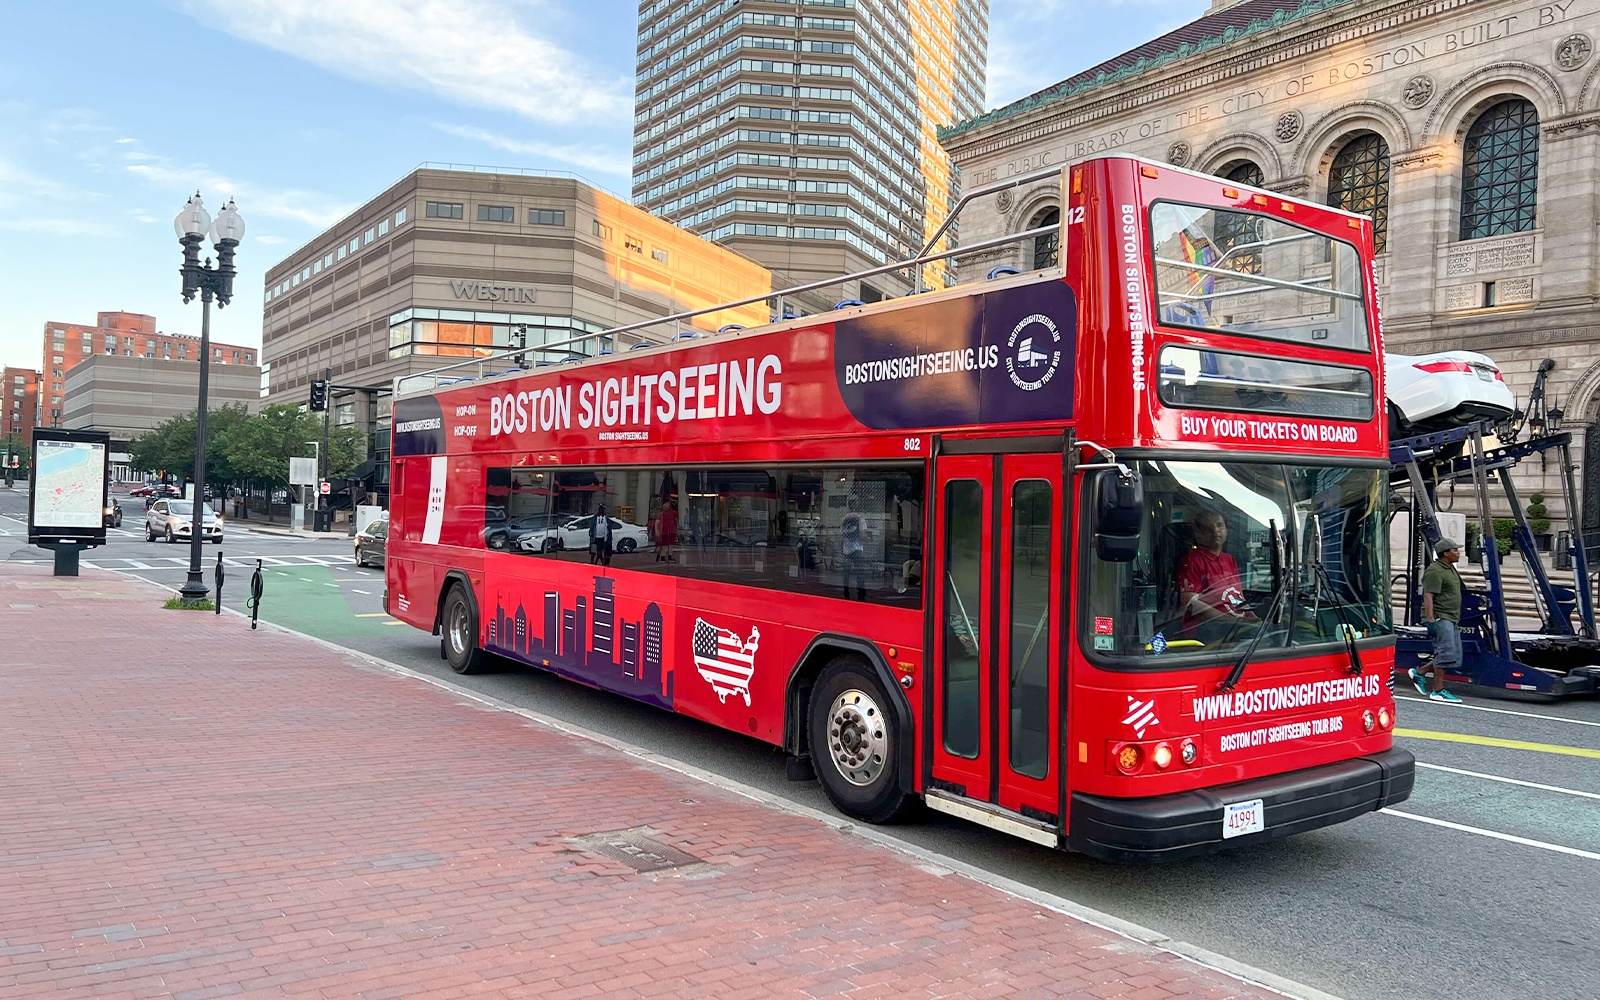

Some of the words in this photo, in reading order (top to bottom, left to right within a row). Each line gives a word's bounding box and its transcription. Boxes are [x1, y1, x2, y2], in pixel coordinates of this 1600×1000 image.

[974, 168, 998, 184] THE
[1007, 152, 1051, 176] PUBLIC
[1064, 129, 1129, 160] LIBRARY
[1140, 120, 1161, 138] OF
[1176, 106, 1209, 127] THE
[1222, 88, 1269, 114] CITY
[1286, 75, 1314, 96] OF
[1329, 42, 1427, 85] BOSTON
[1446, 16, 1518, 51] BUILT
[1539, 0, 1575, 26] BY
[1067, 206, 1085, 225] 12
[1121, 204, 1139, 264] BOSTON
[451, 280, 538, 303] WESTIN
[1007, 314, 1061, 348] BOSTONSIGHTSEEING.US
[1126, 268, 1146, 392] SIGHTSEEING.US
[845, 344, 999, 385] BOSTONSIGHTSEEING.US
[1005, 356, 1015, 373] CITY
[1052, 350, 1061, 368] BUS
[1009, 371, 1042, 391] SIGHTSEEING
[1040, 366, 1056, 385] TOUR
[490, 384, 572, 436] BOSTON
[578, 354, 782, 429] SIGHTSEEING
[455, 405, 477, 417] HOP-ON
[453, 425, 478, 437] HOP-OFF
[1181, 416, 1209, 435] BUY
[1211, 417, 1247, 438] YOUR
[1248, 421, 1299, 440] TICKETS
[1301, 424, 1318, 441] ON
[1320, 425, 1358, 443] BOARD
[904, 438, 921, 450] 802
[1193, 674, 1380, 722] WWW.BOSTONSIGHTSEEING.US
[1220, 731, 1251, 752] BOSTON
[1251, 728, 1267, 747] CITY
[1267, 722, 1312, 743] SIGHTSEEING
[1312, 719, 1329, 735] TOUR
[1330, 716, 1343, 731] BUS
[1229, 810, 1257, 829] 41991
